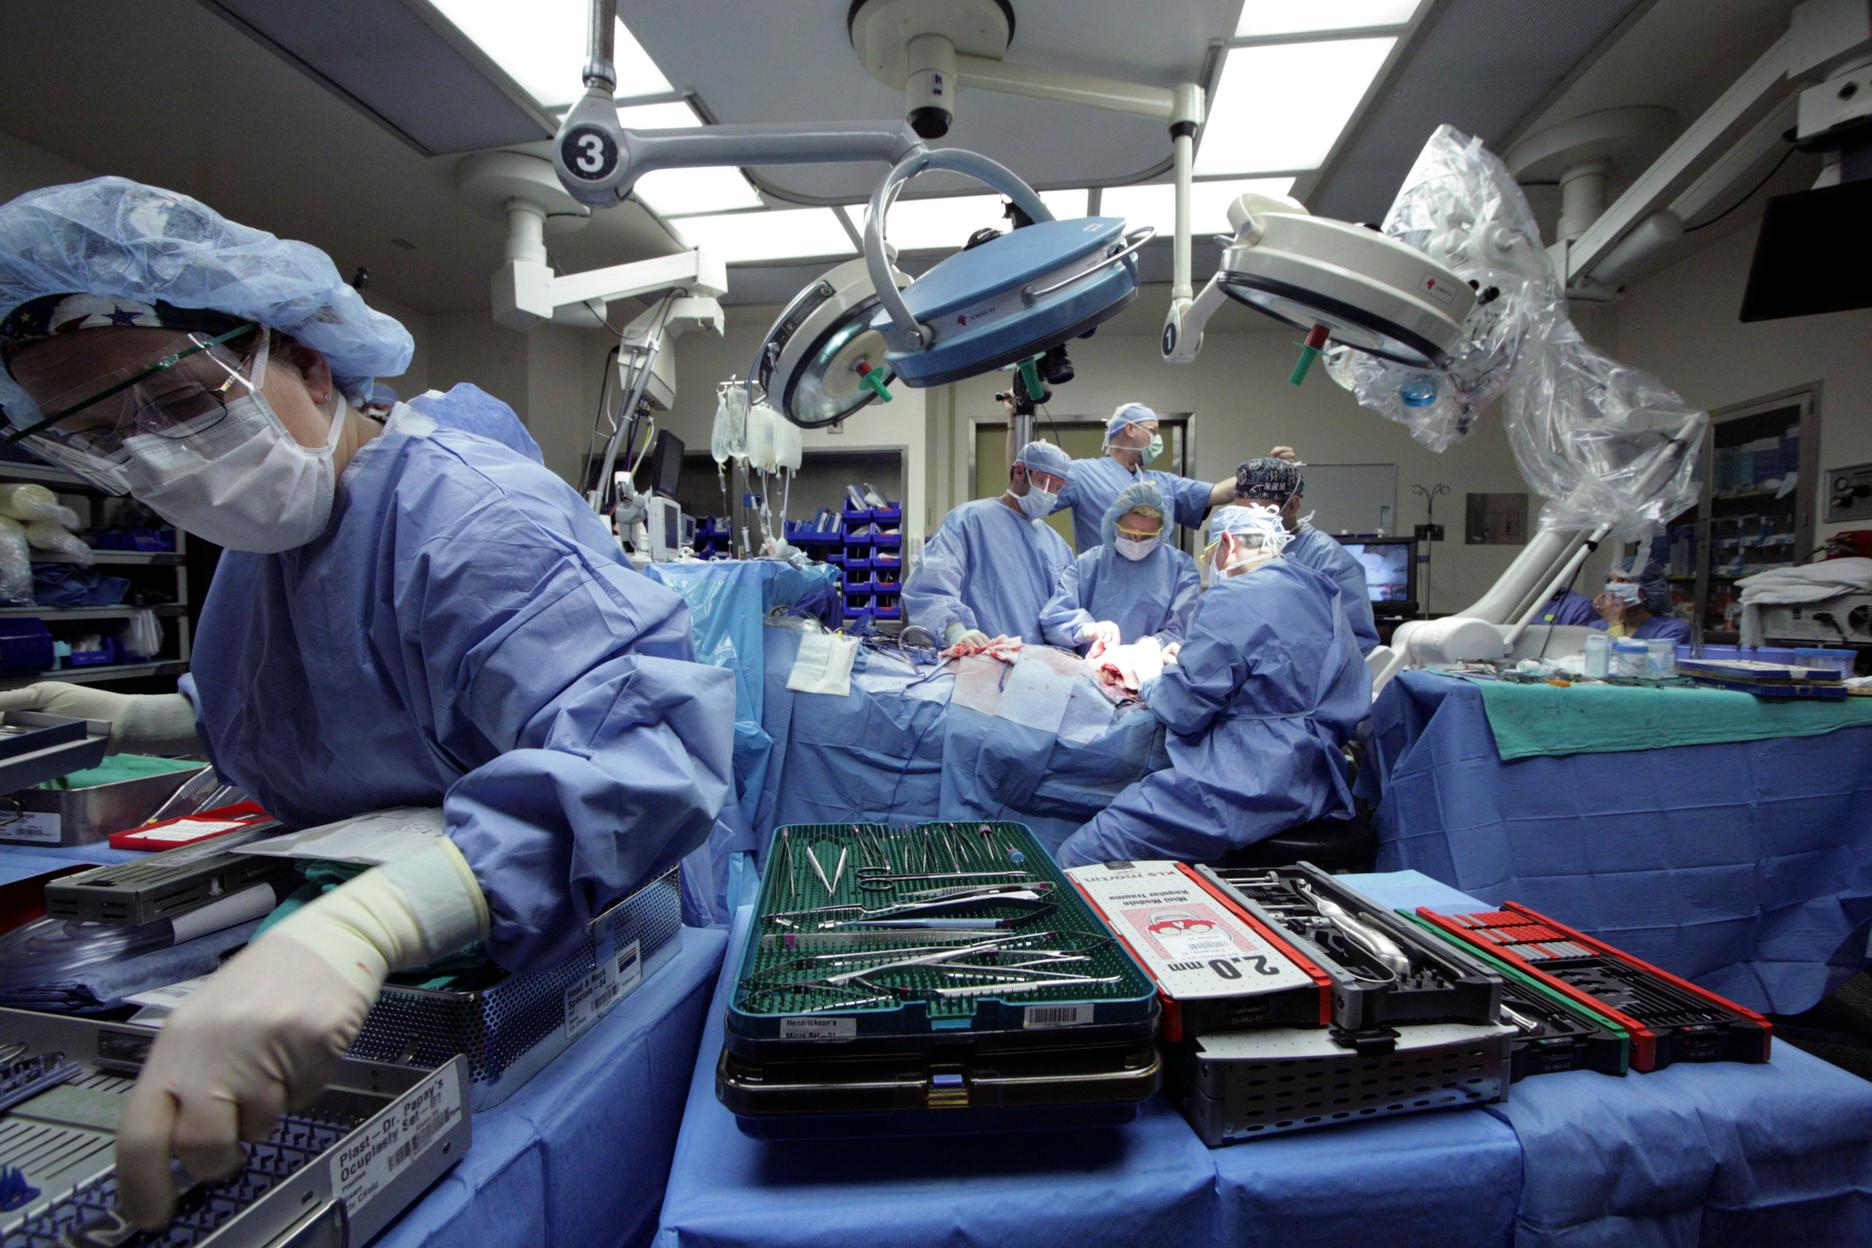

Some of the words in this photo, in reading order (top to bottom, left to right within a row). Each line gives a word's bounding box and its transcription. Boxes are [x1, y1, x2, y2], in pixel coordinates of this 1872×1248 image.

[577, 134, 604, 173] 3
[1166, 328, 1172, 350] 1
[1109, 893, 1146, 901] Trauma
[1148, 889, 1189, 898] Regular
[1122, 899, 1162, 907] Module
[1168, 961, 1204, 972] mm
[1208, 955, 1280, 980] 2.0
[786, 1019, 837, 1027] Hendrickson's
[340, 1136, 370, 1168] Plast
[383, 1116, 400, 1134] Dr.
[404, 1079, 443, 1117] Papay's
[341, 1129, 398, 1181] Ocuplasty
[402, 1110, 419, 1132] Set
